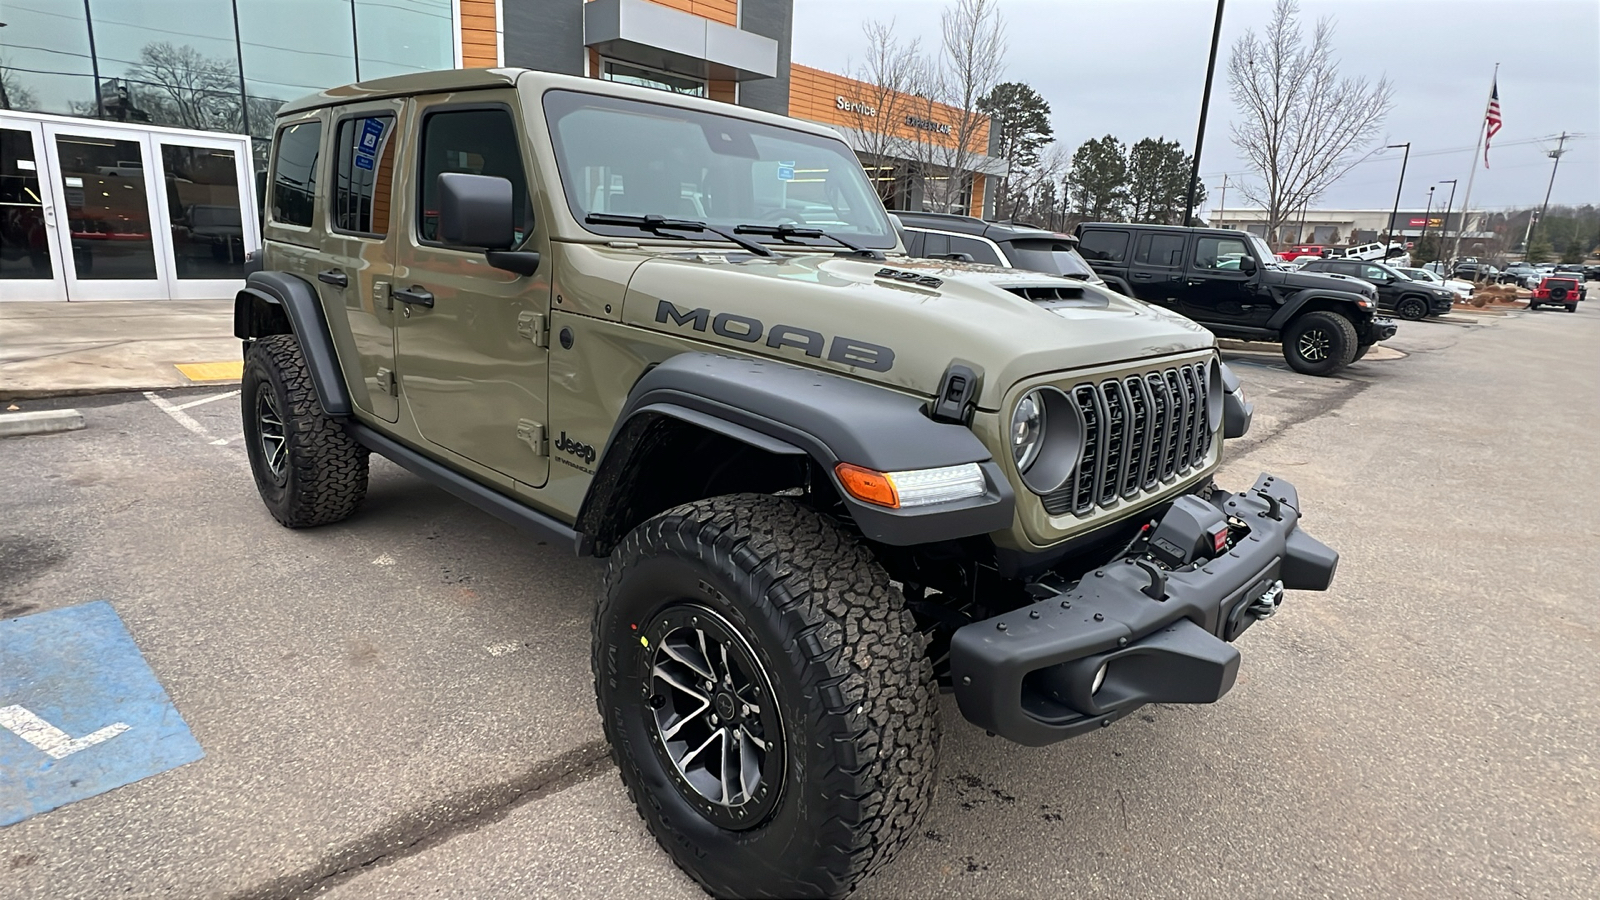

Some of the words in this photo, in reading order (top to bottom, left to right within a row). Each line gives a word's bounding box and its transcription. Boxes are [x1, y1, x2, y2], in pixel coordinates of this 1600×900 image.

[836, 96, 876, 117] Service
[655, 300, 896, 373] MOAB
[555, 431, 596, 465] Jeep
